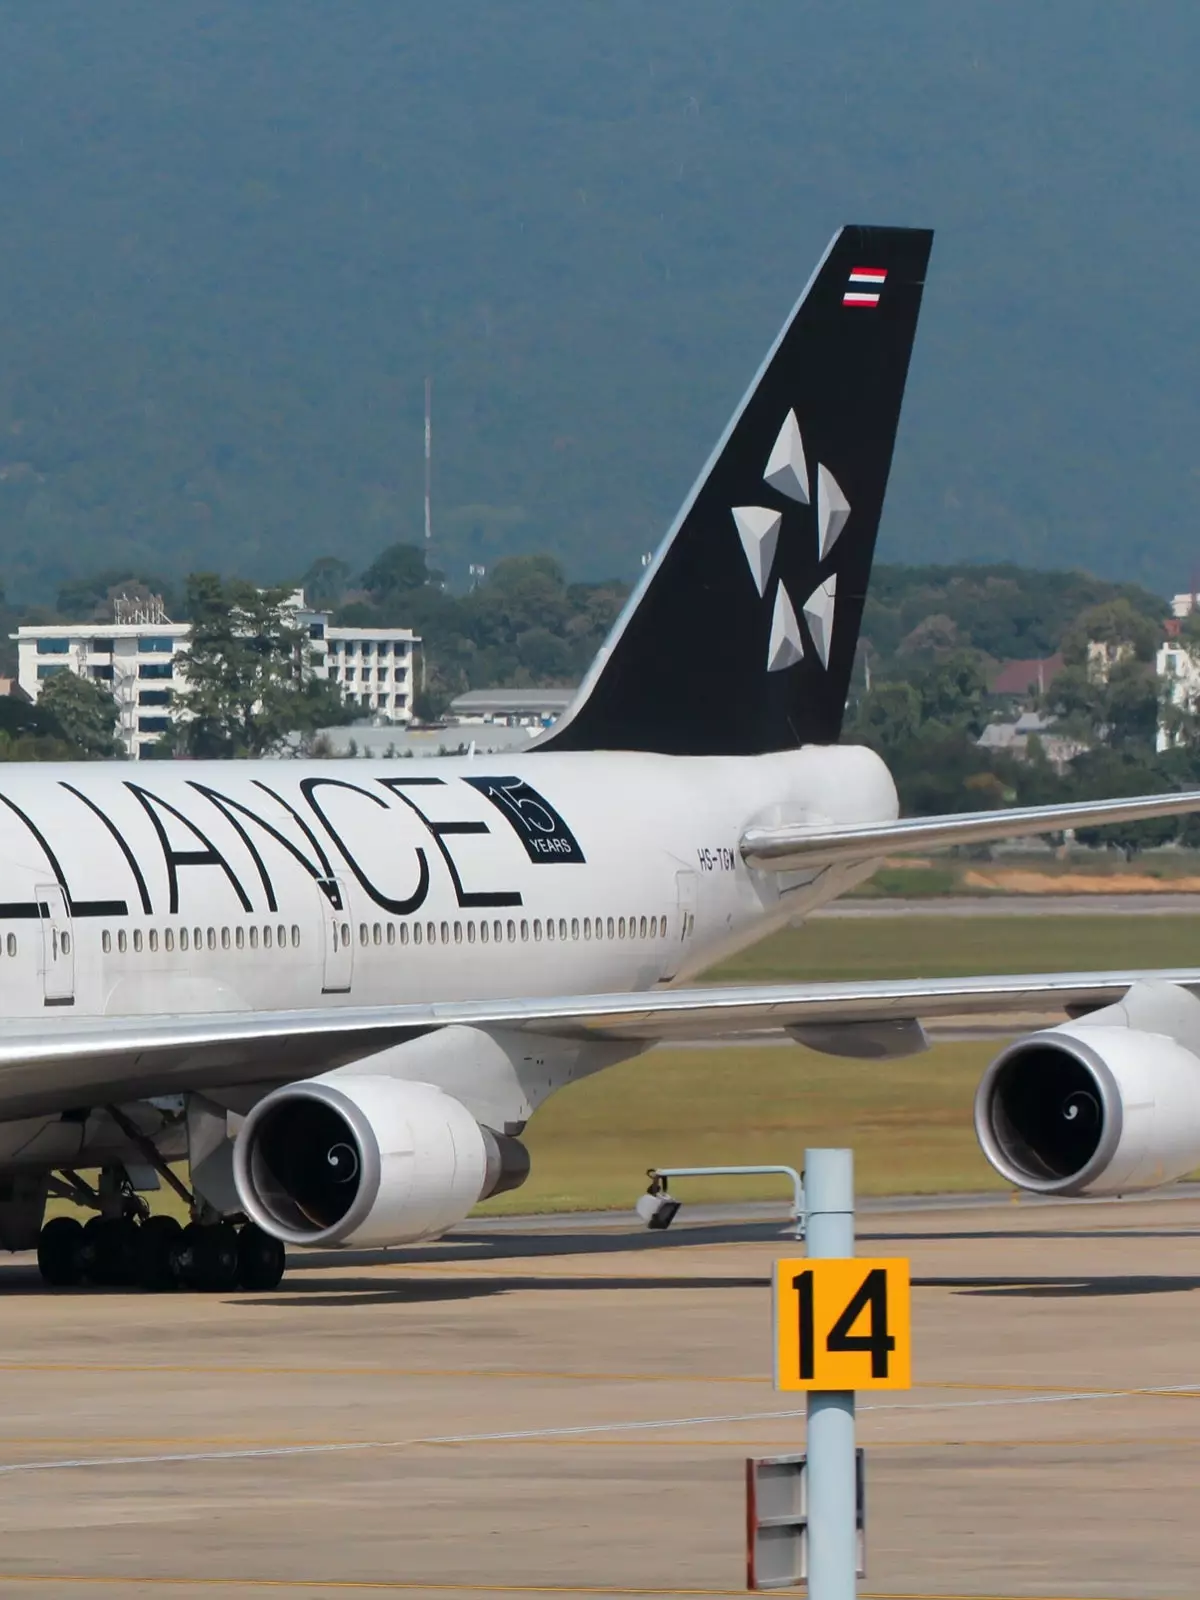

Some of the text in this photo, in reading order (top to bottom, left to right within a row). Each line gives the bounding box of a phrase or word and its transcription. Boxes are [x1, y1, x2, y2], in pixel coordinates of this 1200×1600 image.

[488, 780, 555, 832] 15
[529, 838, 572, 853] YEARS
[697, 848, 736, 871] HS-TGW
[792, 1268, 896, 1380] 14
